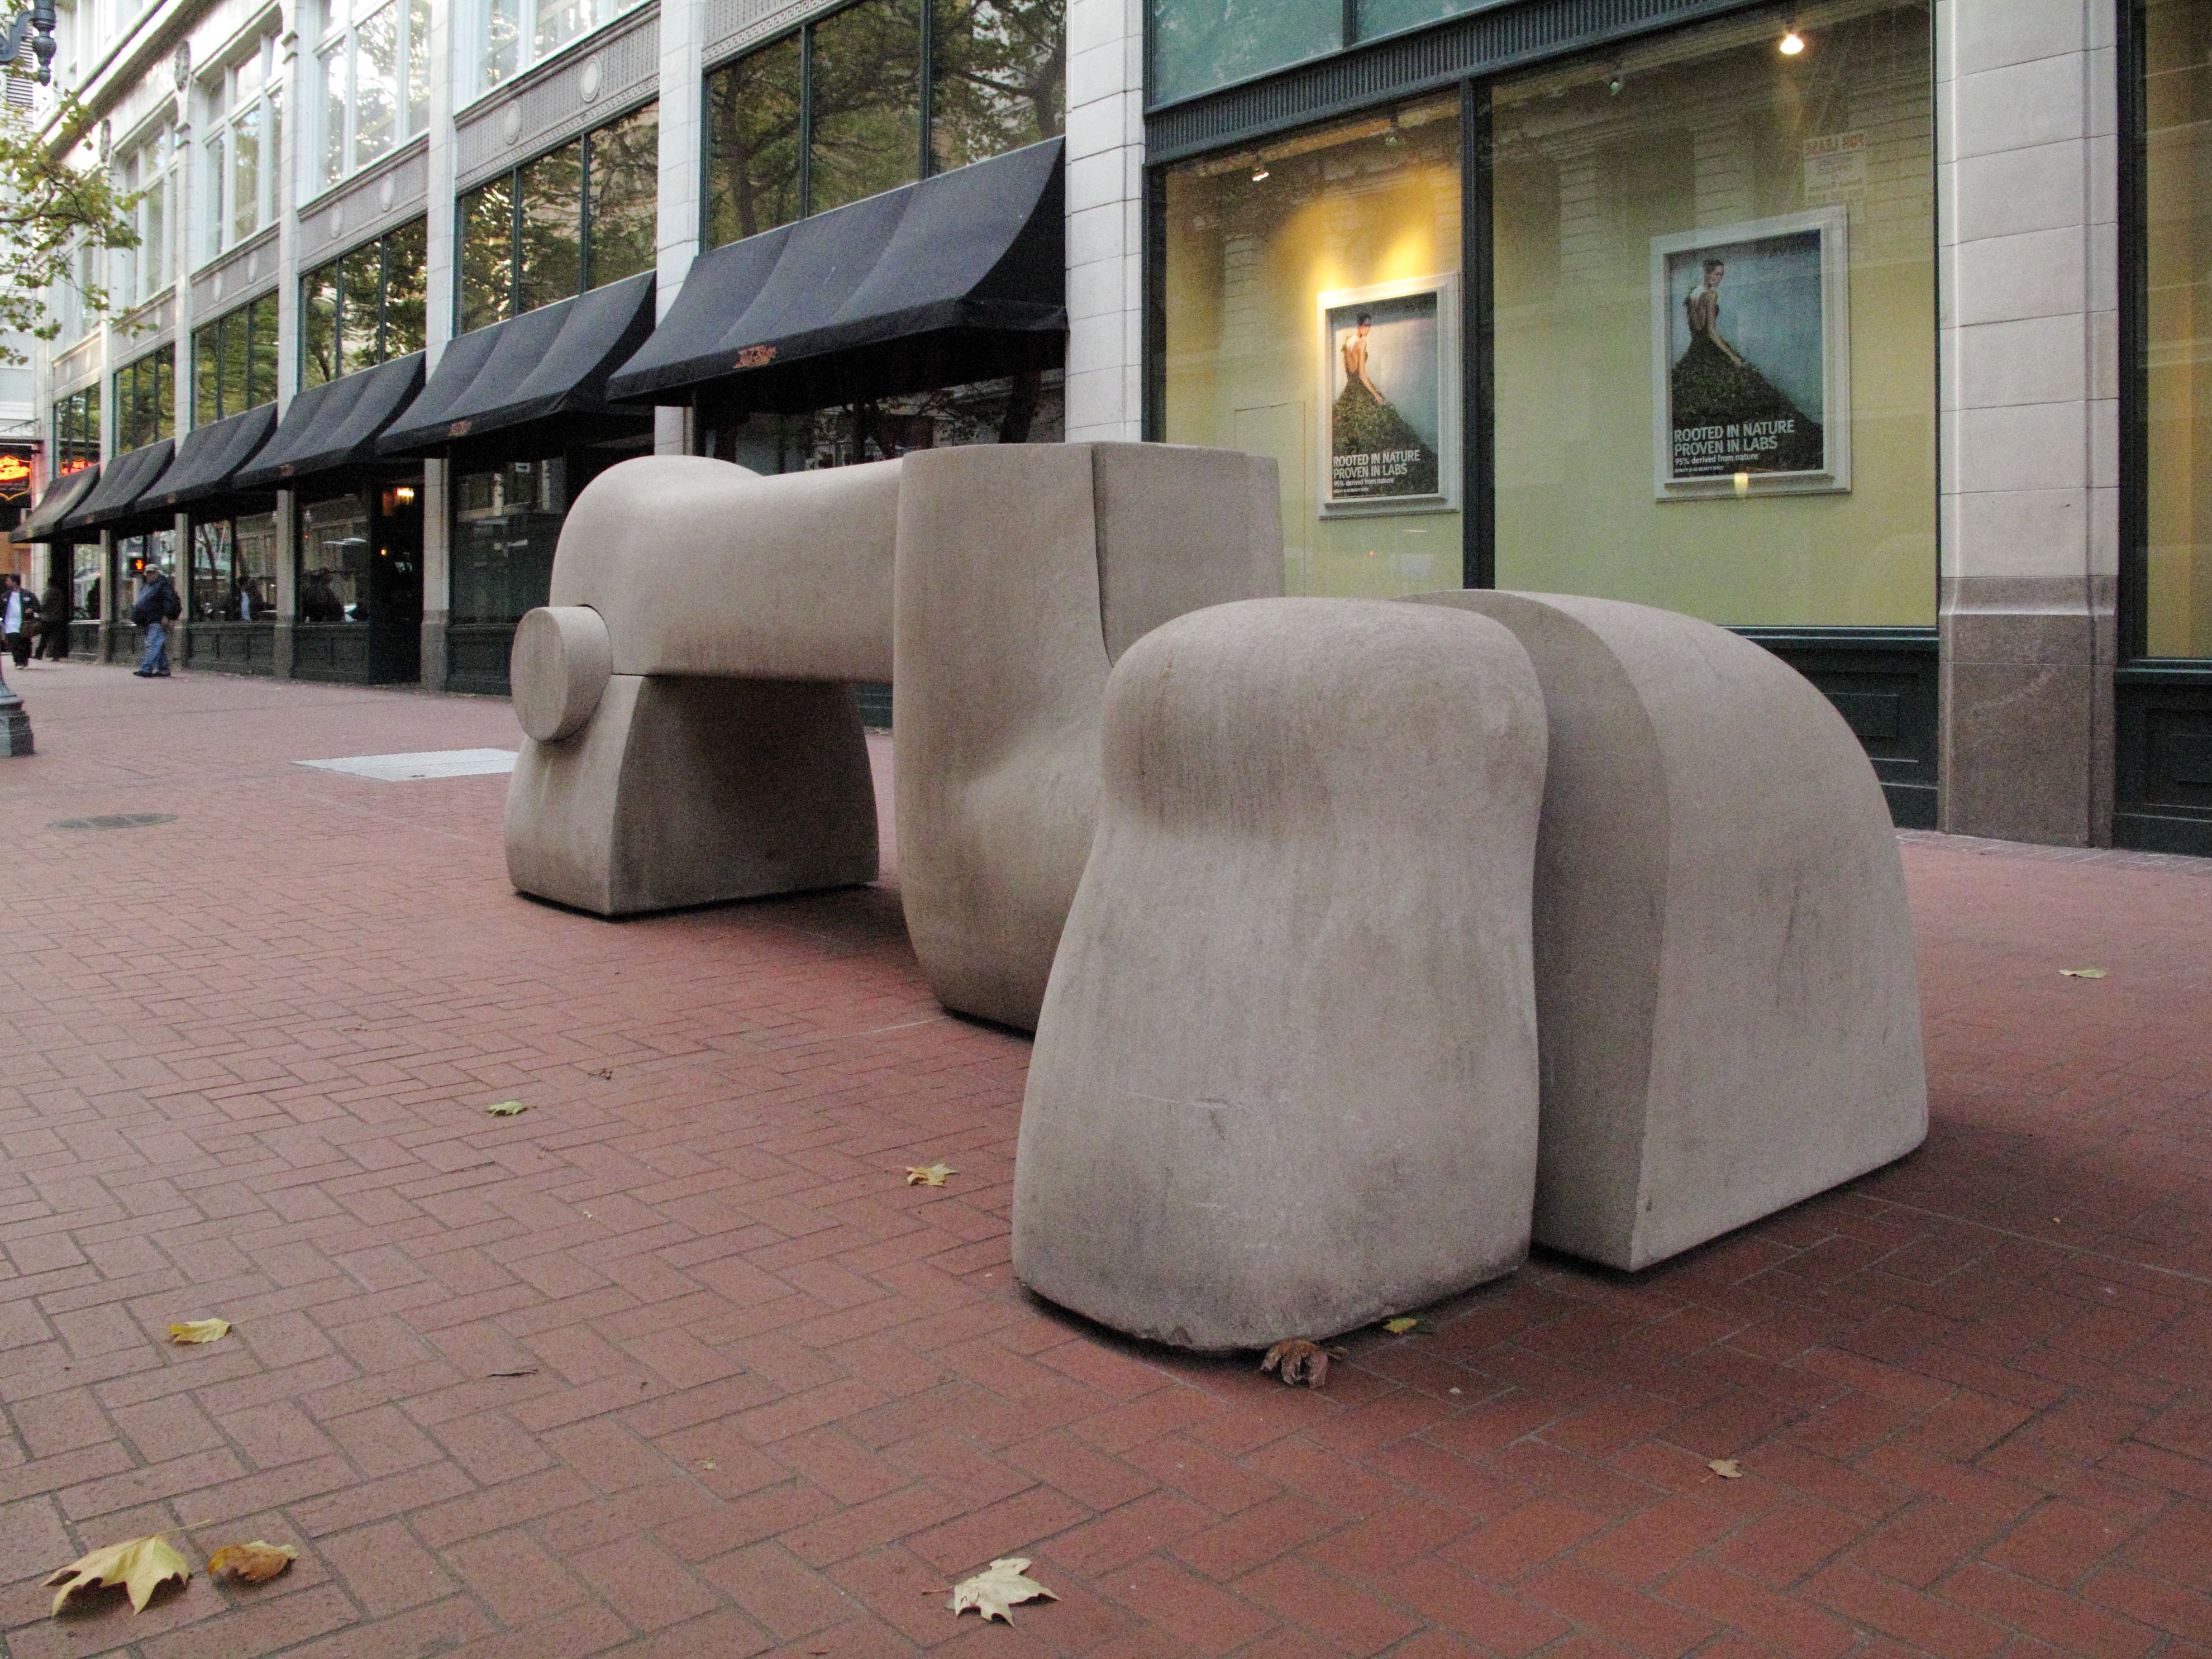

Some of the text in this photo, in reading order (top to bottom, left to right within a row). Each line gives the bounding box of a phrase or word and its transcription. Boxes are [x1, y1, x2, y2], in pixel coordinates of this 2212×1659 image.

[1674, 419, 1795, 442] ROOTED IN NATURE
[1674, 436, 1778, 456] PROVEN IN LABS
[1333, 449, 1420, 467] ROOTED IN NATURE
[1675, 457, 1690, 465] 95%
[1691, 455, 1716, 464] derived
[1333, 463, 1408, 479] PROVEN IN LABS
